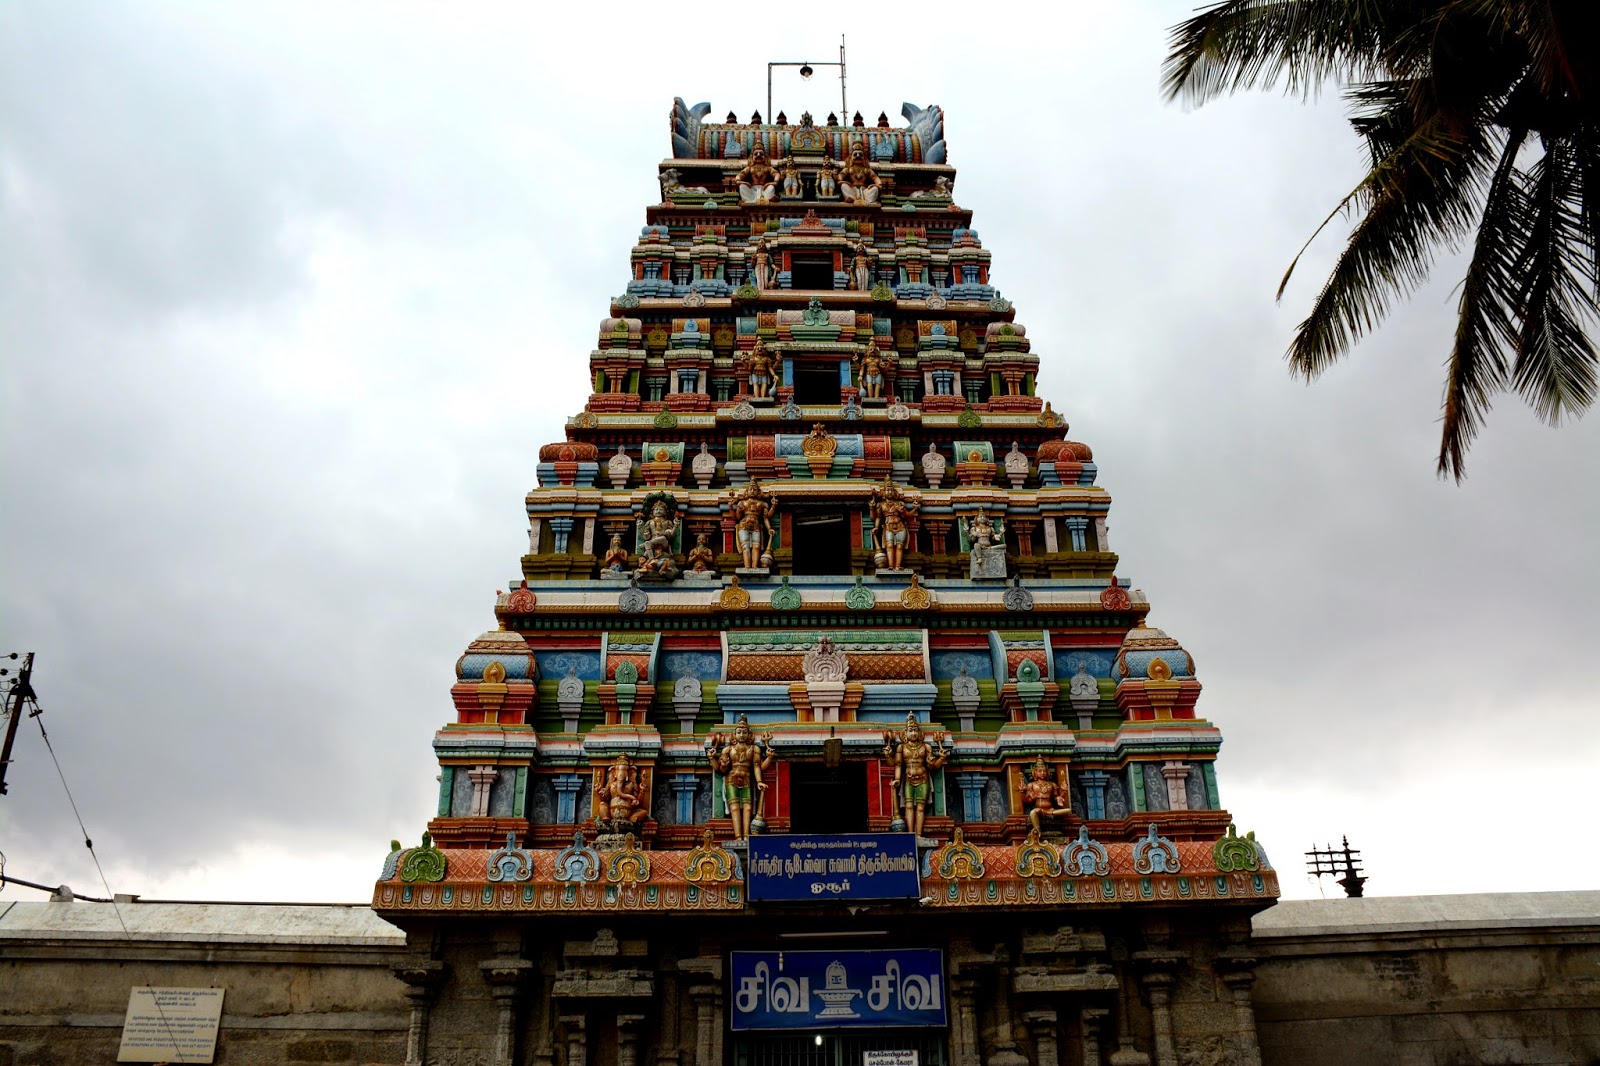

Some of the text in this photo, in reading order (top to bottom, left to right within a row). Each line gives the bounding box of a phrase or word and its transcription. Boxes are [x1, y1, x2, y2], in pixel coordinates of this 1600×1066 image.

[828, 854, 856, 873] சுவாமி
[857, 851, 916, 877] திருக்கோயில்
[811, 878, 850, 894] ஓசூர்
[736, 959, 942, 1013] சிவ சிவ
